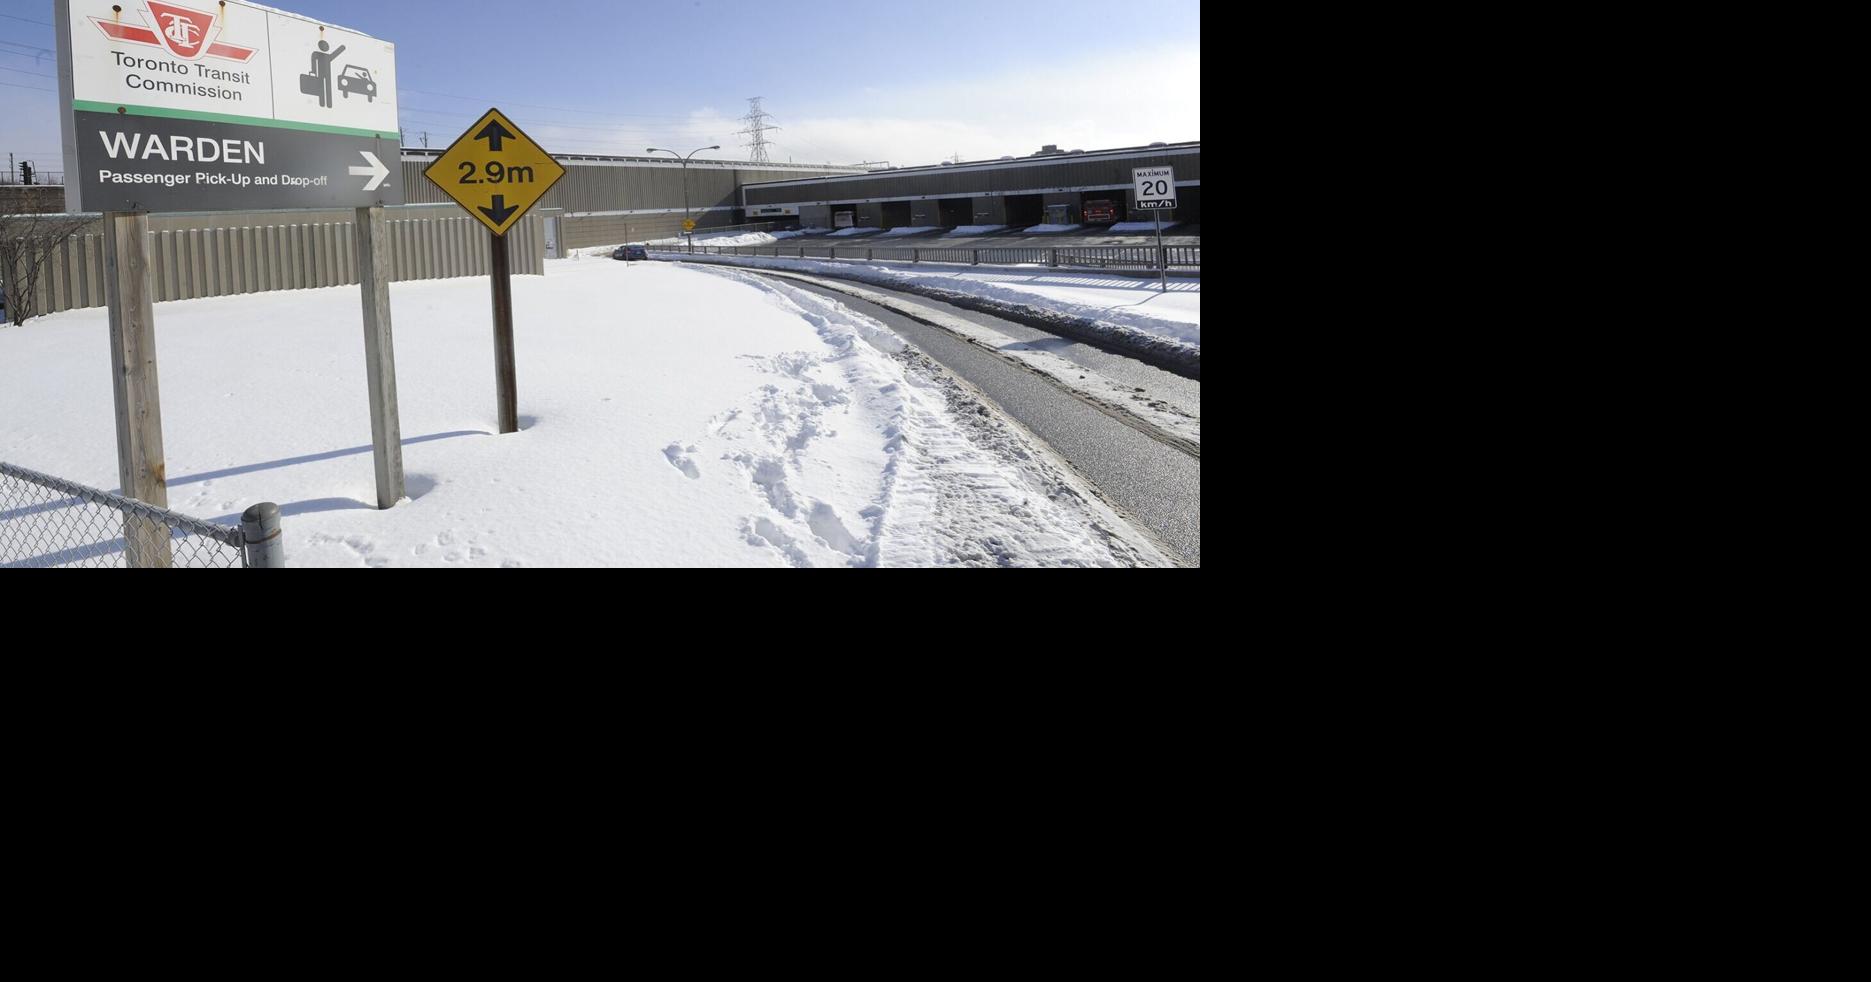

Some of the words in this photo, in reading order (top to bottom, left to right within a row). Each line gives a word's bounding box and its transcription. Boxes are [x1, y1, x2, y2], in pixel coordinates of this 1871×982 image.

[111, 50, 188, 75] Toronto
[194, 63, 250, 85] Transit
[126, 74, 242, 101] Commission
[99, 130, 265, 165] WARDEN
[99, 169, 191, 187] Passenger
[195, 172, 251, 188] Pick-Up
[254, 174, 278, 186] and
[281, 174, 328, 188] Drop-off
[458, 160, 534, 185] 2.9m
[1141, 180, 1168, 196] 20
[1140, 200, 1172, 208] km/h
